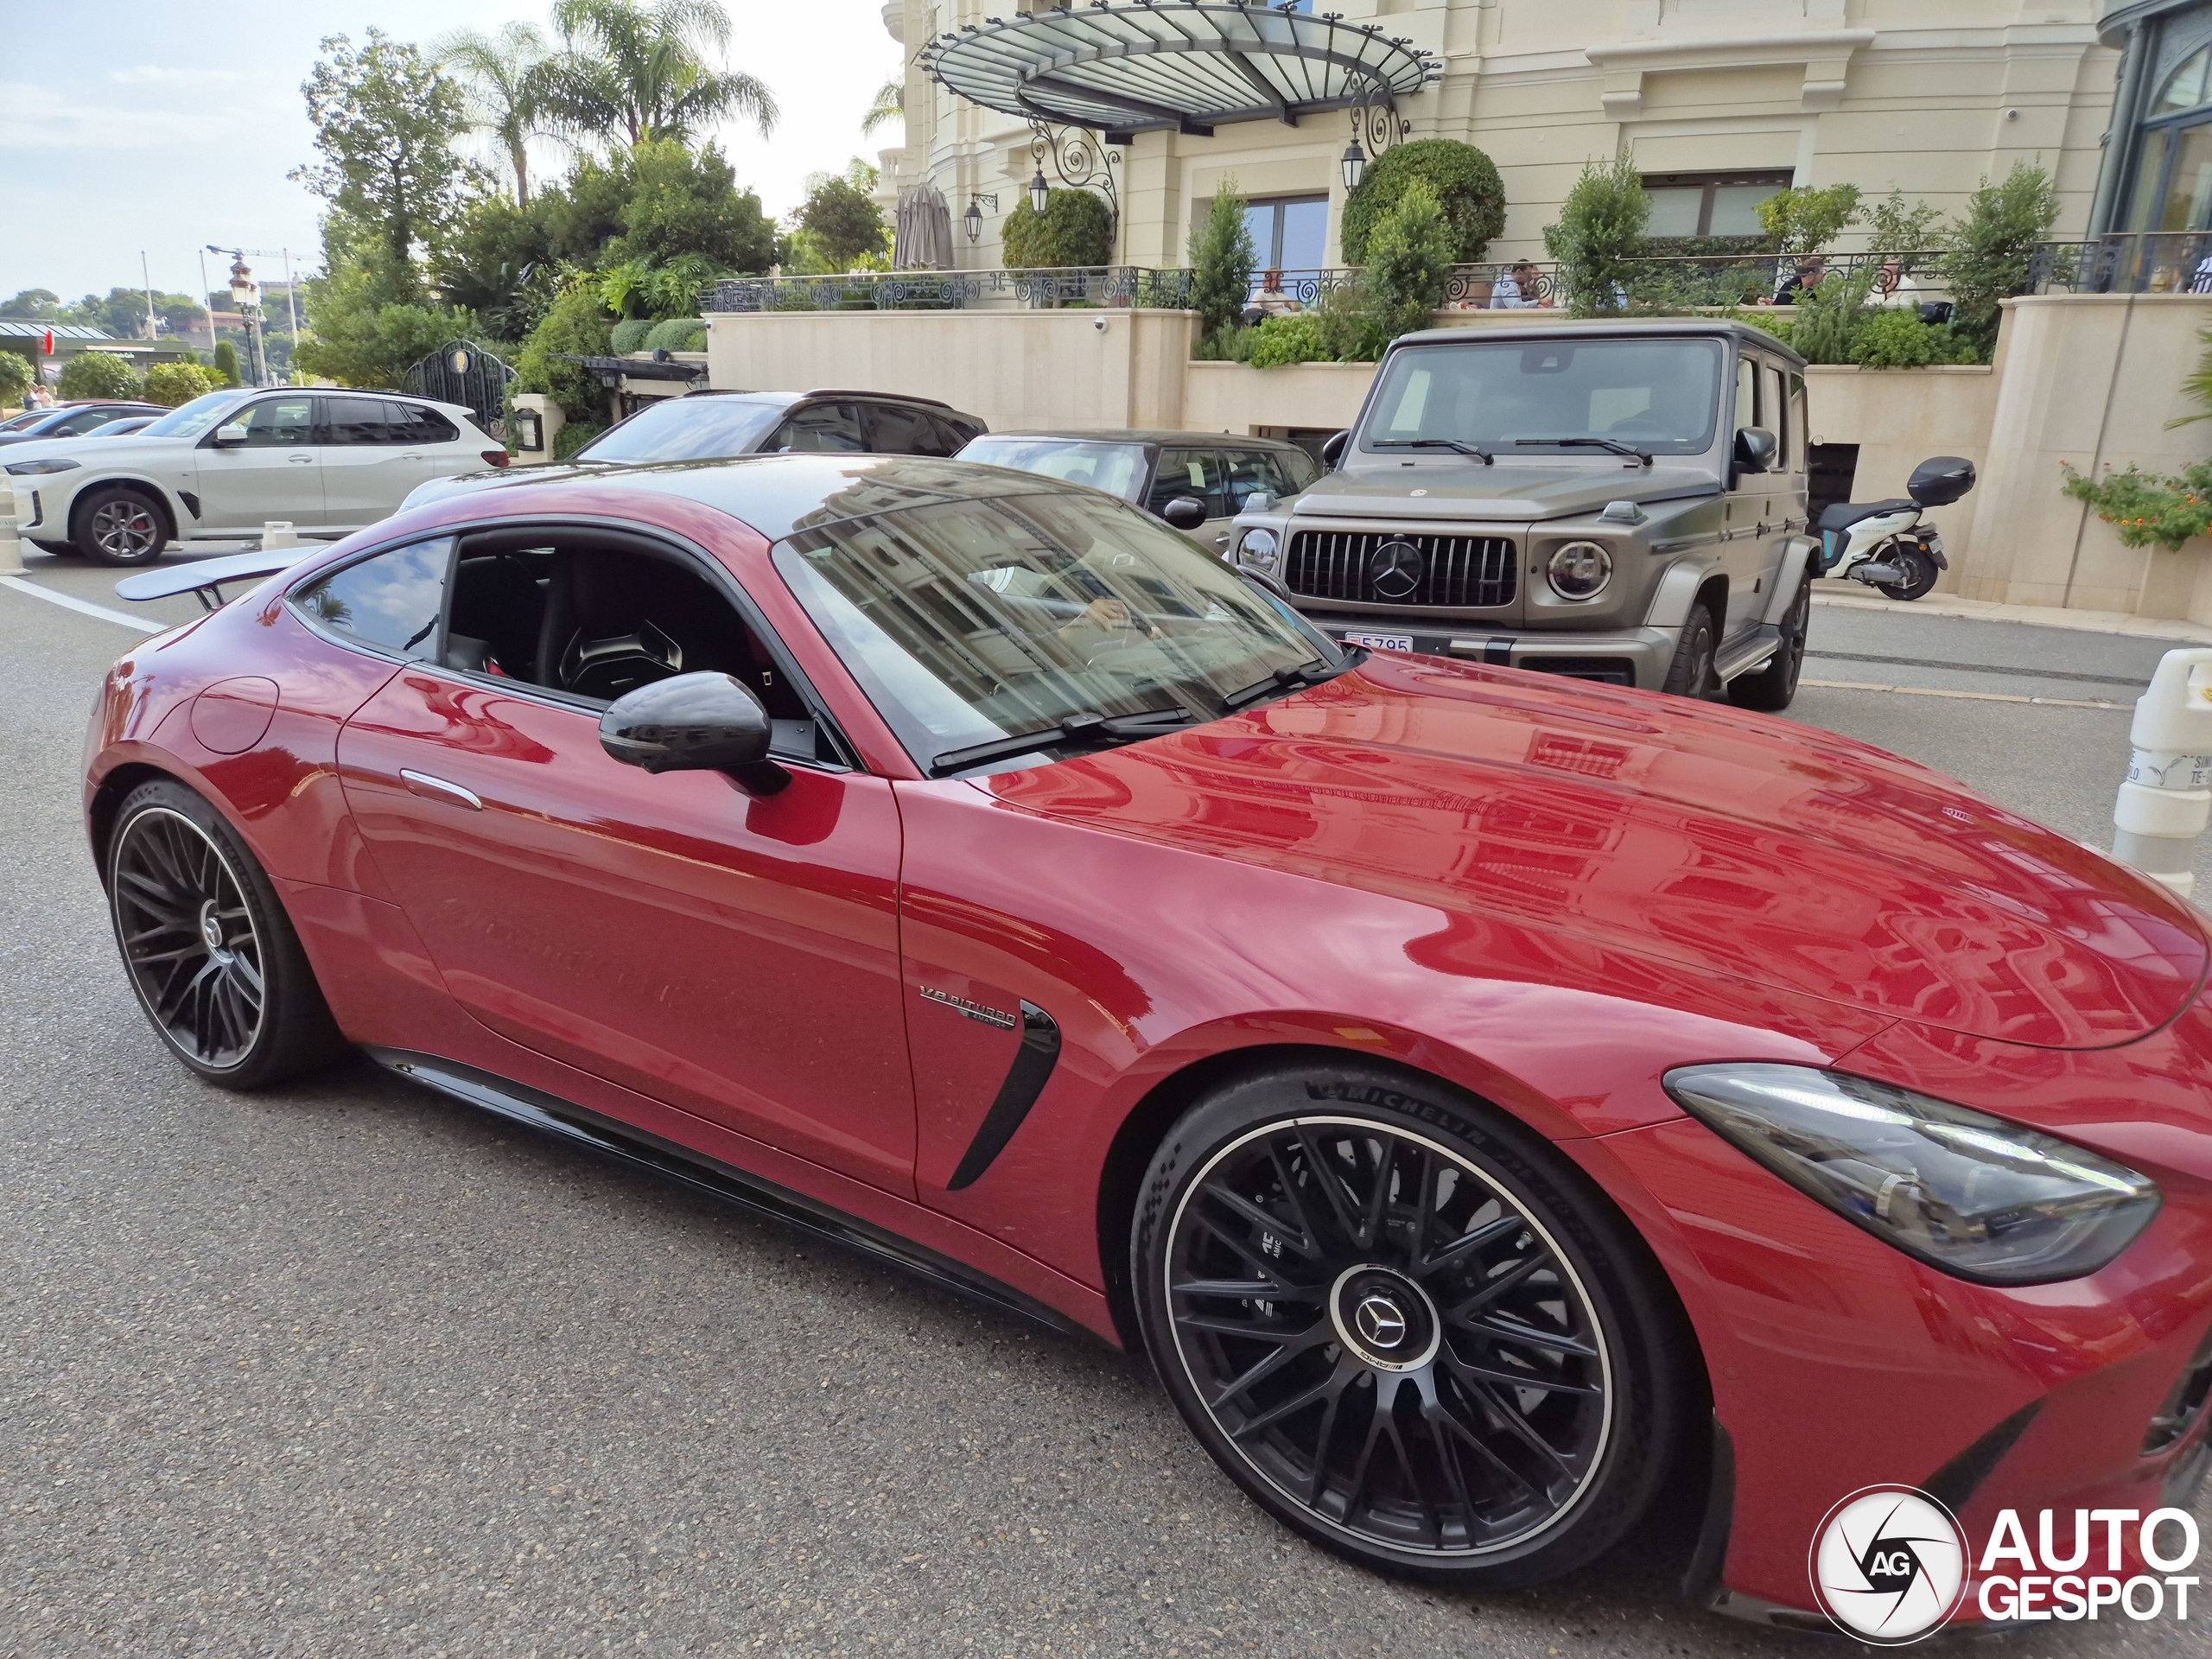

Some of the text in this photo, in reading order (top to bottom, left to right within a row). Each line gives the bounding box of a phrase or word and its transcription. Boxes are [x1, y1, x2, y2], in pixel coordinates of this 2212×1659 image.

[1363, 637, 1408, 652] 5795
[919, 985, 1017, 1023] V8 BITURBO
[1346, 1085, 1487, 1145] MICHELIN
[1359, 1351, 1389, 1369] AMG
